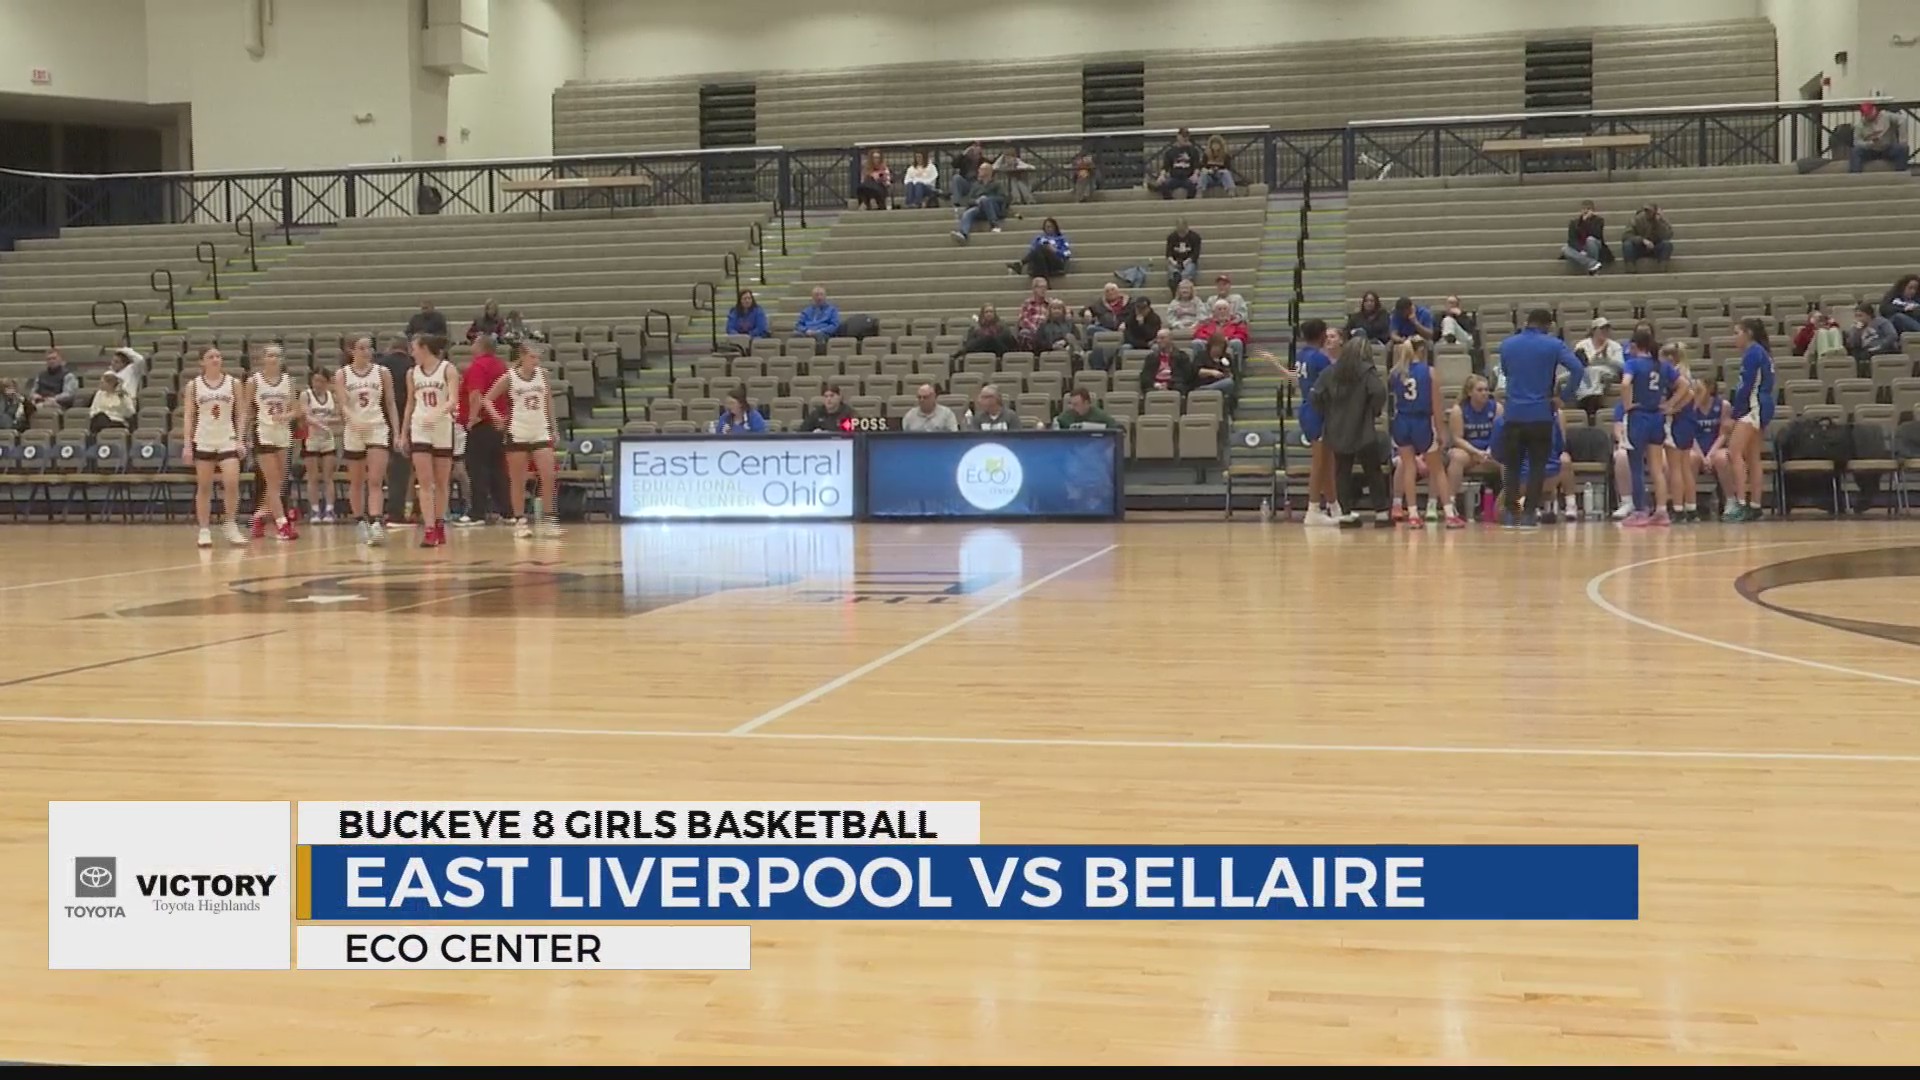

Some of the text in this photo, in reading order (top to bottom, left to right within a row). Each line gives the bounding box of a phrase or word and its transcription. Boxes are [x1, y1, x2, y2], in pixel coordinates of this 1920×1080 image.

[1403, 378, 1418, 401] 3
[1648, 371, 1660, 391] 2
[358, 391, 369, 408] 5
[423, 391, 437, 408] 10
[524, 395, 539, 410] 12
[632, 449, 841, 477] East Central
[632, 479, 744, 494] EDUCATIONAL
[762, 480, 840, 507] Ohio
[632, 493, 756, 508] SERVICE CENTER
